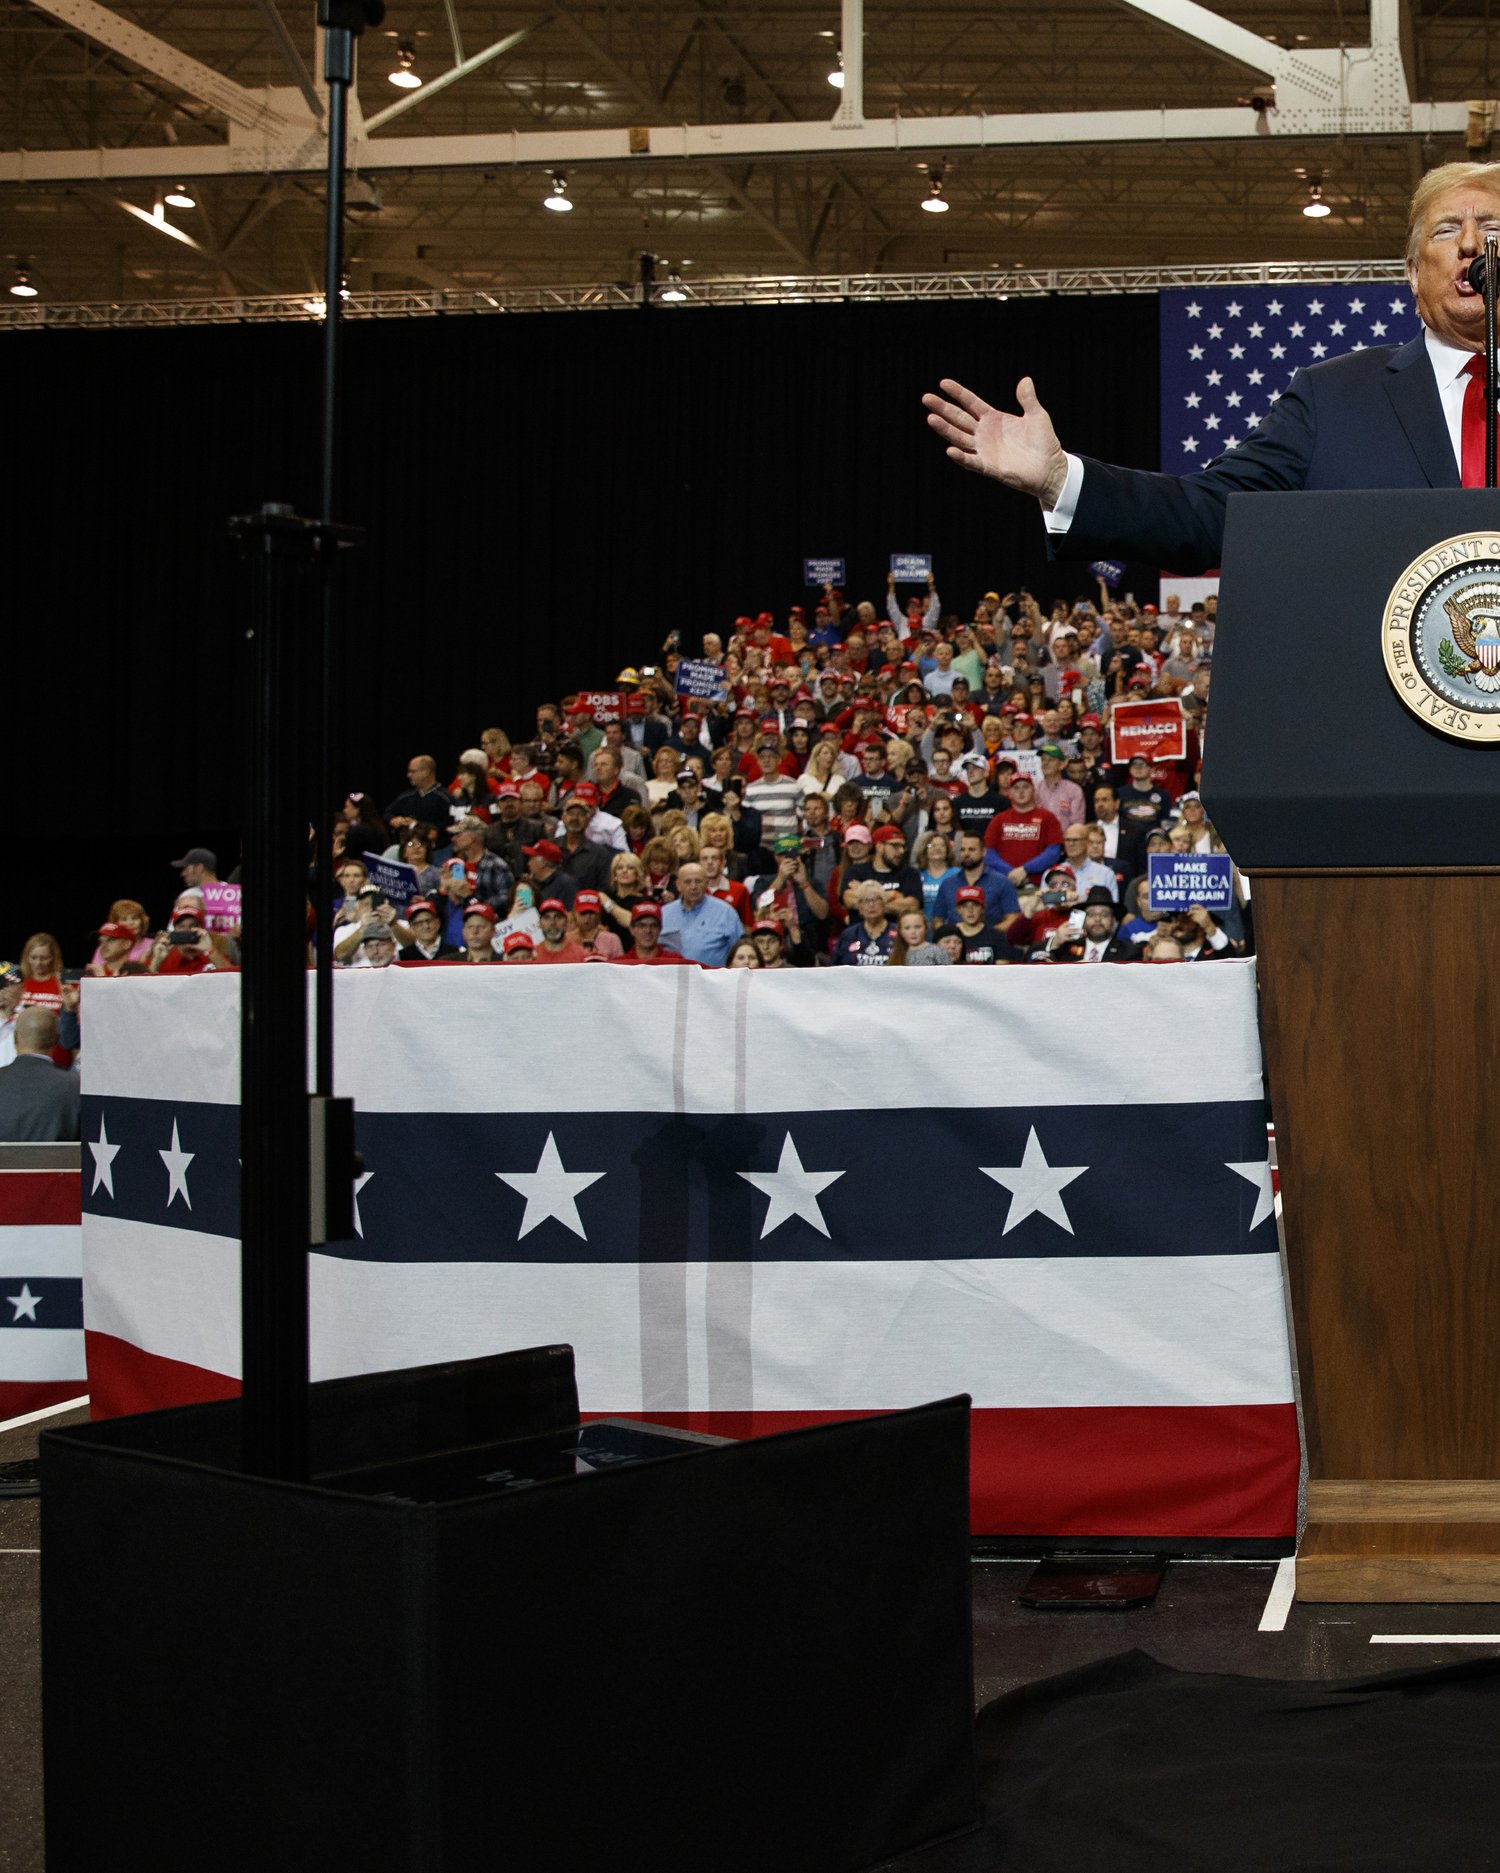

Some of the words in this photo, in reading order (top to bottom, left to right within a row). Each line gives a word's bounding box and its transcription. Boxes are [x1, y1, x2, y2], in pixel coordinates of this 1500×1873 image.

[895, 558, 925, 566] DRAIN
[1389, 540, 1482, 633] PRESIDENT
[1392, 639, 1408, 669] THE
[682, 663, 724, 677] PROMISES
[691, 672, 714, 682] MADE
[1400, 670, 1418, 690] OF
[690, 688, 710, 696] KEPT
[586, 694, 619, 706] JOBS
[1417, 687, 1470, 730] SEAL
[594, 711, 619, 721] OBS
[1120, 723, 1177, 736] RENACCI
[377, 865, 400, 878] KEEP
[1173, 862, 1207, 873] MAKE
[1151, 874, 1229, 889] AMERICA
[1156, 890, 1184, 901] SAFE
[1188, 890, 1225, 901] AGAIN
